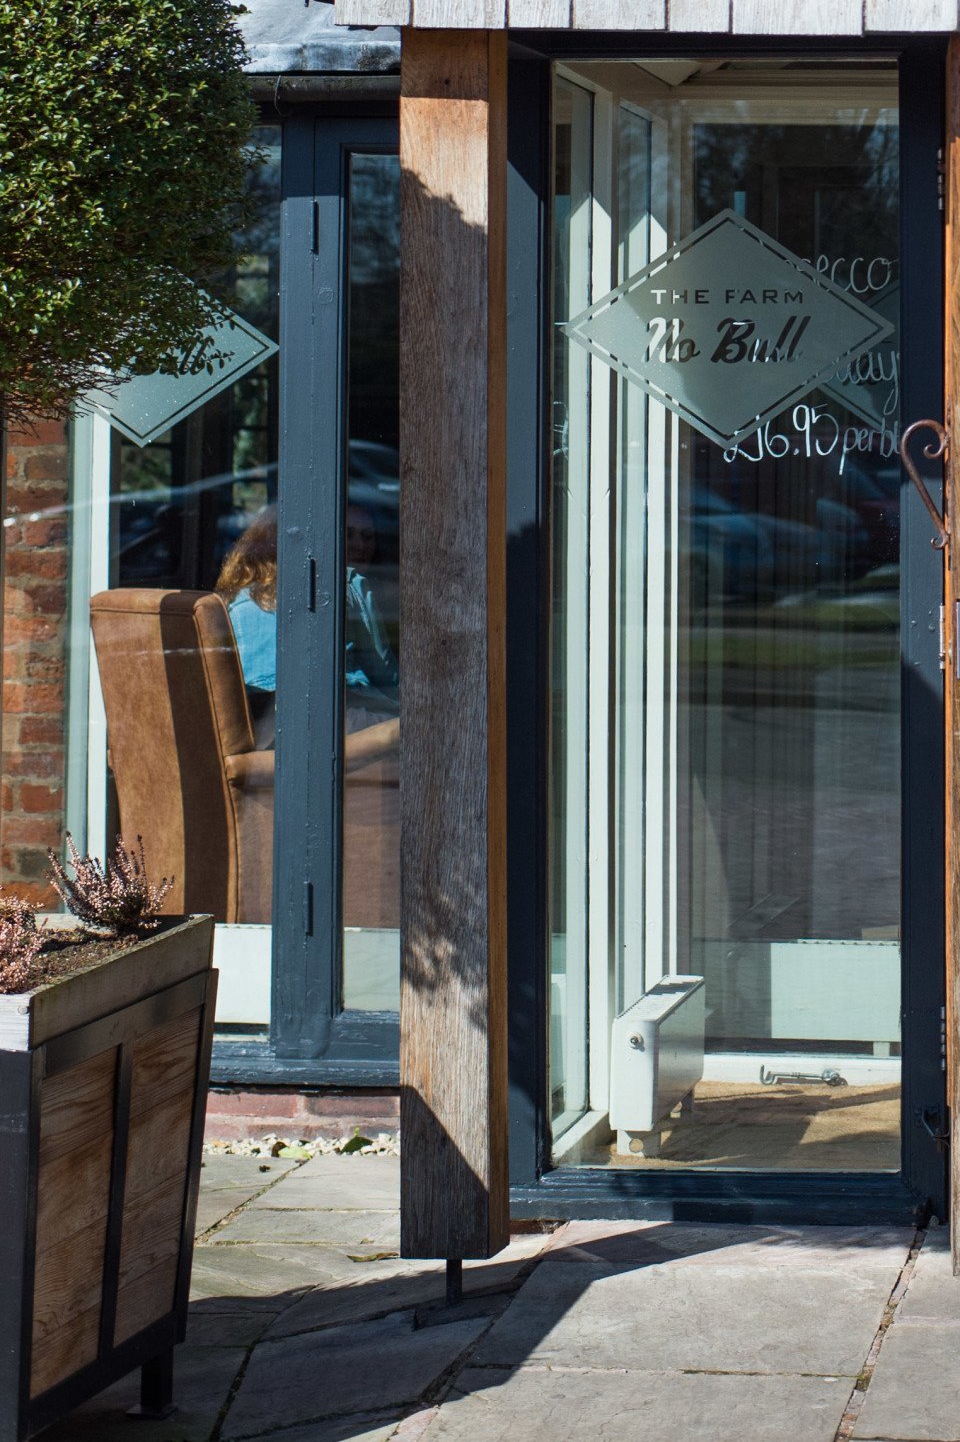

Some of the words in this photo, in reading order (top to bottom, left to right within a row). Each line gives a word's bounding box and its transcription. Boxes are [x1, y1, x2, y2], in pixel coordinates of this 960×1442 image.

[650, 289, 710, 305] THE
[725, 289, 804, 305] FARM
[643, 316, 701, 364] No
[711, 315, 812, 364] Bull
